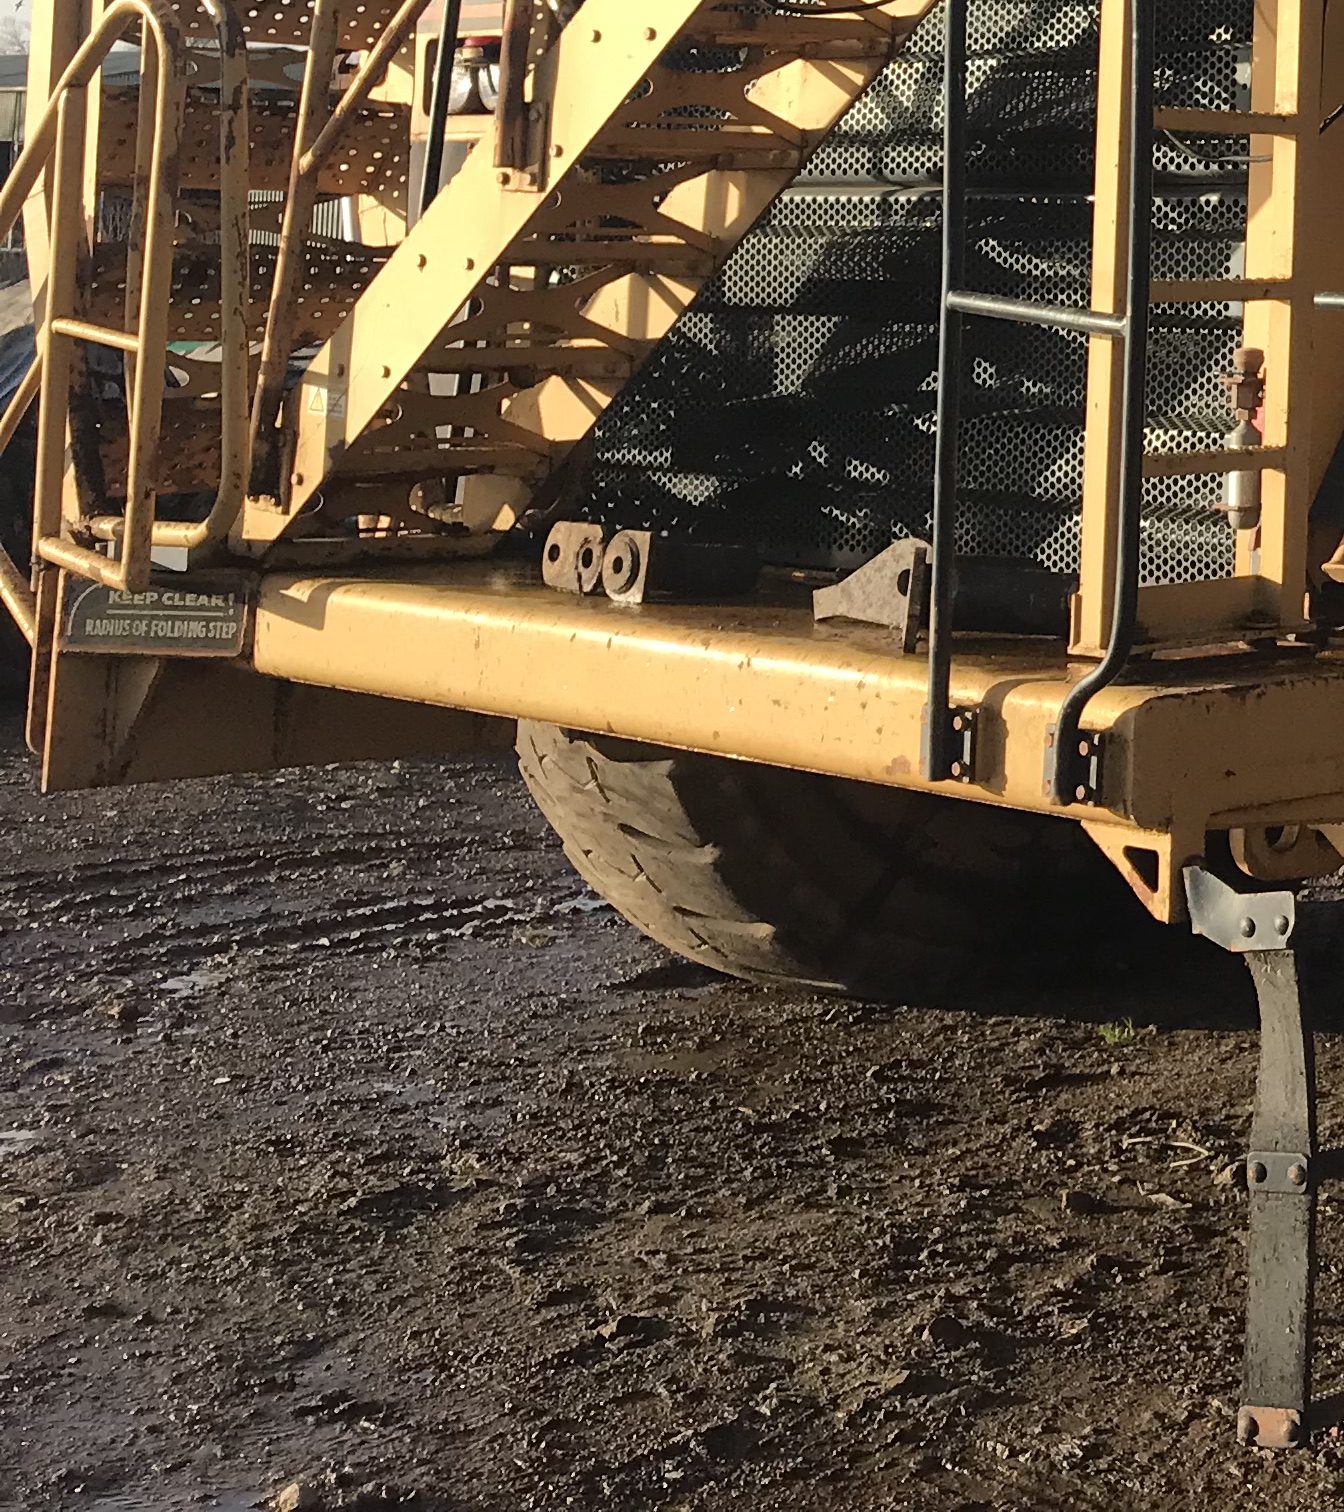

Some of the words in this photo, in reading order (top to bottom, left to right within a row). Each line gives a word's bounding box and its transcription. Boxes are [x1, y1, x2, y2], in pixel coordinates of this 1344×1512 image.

[108, 590, 158, 606] KEEP
[85, 619, 131, 636] RADIUS
[132, 620, 149, 636] OF
[150, 620, 206, 638] FOLDING
[207, 621, 237, 639] STEP
